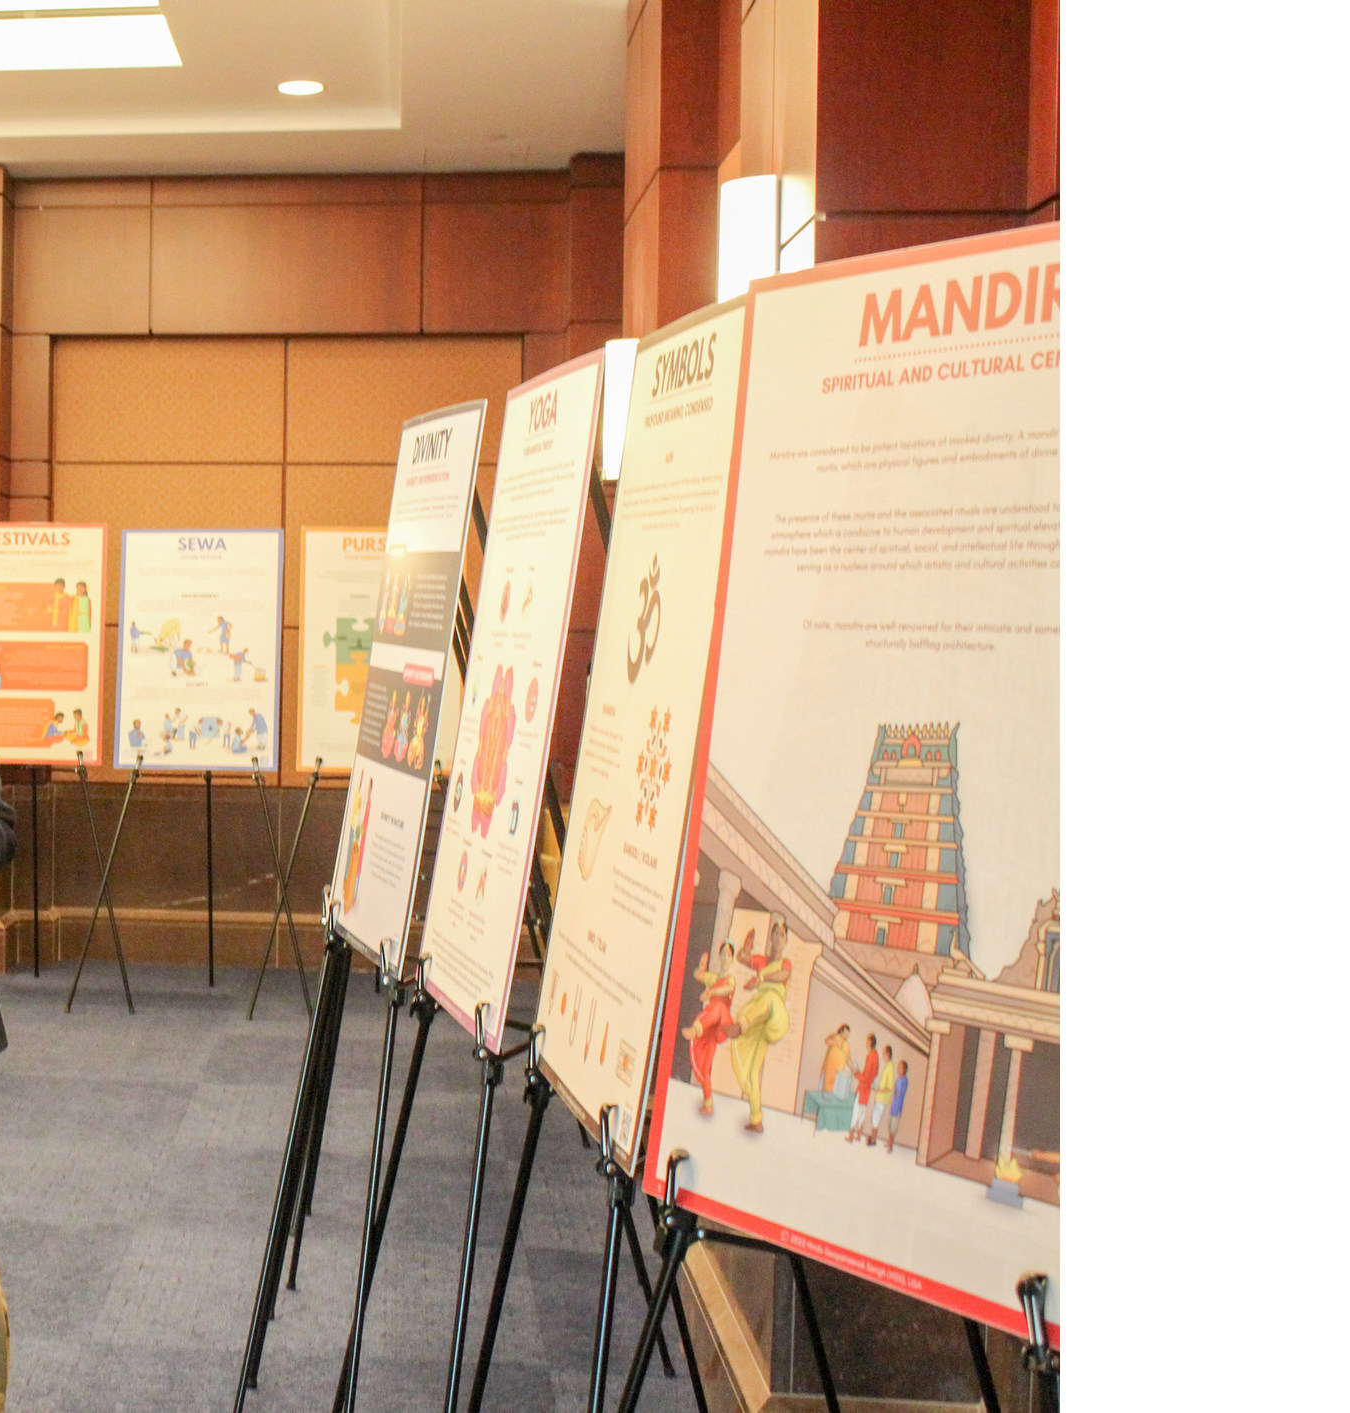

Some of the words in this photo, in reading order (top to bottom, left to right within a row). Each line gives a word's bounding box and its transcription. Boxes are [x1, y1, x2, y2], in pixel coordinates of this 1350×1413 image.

[652, 331, 716, 397] SYMBOLS
[821, 370, 894, 394] SPIRITUAL
[899, 364, 932, 385] AND
[937, 353, 1025, 380] CULTURAL
[528, 389, 558, 434] YOGA
[412, 427, 453, 465] DIVINITY
[938, 435, 947, 446] of
[1018, 429, 1025, 441] A
[941, 451, 958, 464] and
[960, 448, 1017, 462] embodiments
[1020, 447, 1029, 457] of
[1031, 447, 1058, 458] divine
[877, 508, 892, 519] and
[894, 508, 907, 518] the
[982, 506, 997, 514] are
[1000, 502, 1050, 514] understood
[882, 526, 891, 536] to
[921, 524, 975, 537] development
[977, 522, 994, 533] and
[177, 537, 227, 551] SEWA
[343, 537, 386, 552] PURS
[868, 542, 878, 553] of
[941, 541, 958, 552] and
[960, 539, 1008, 551] intellectual
[1009, 539, 1023, 550] life
[954, 558, 971, 569] and
[973, 557, 1005, 569] cultural
[1007, 558, 1048, 569] activities
[1014, 622, 1032, 634] and
